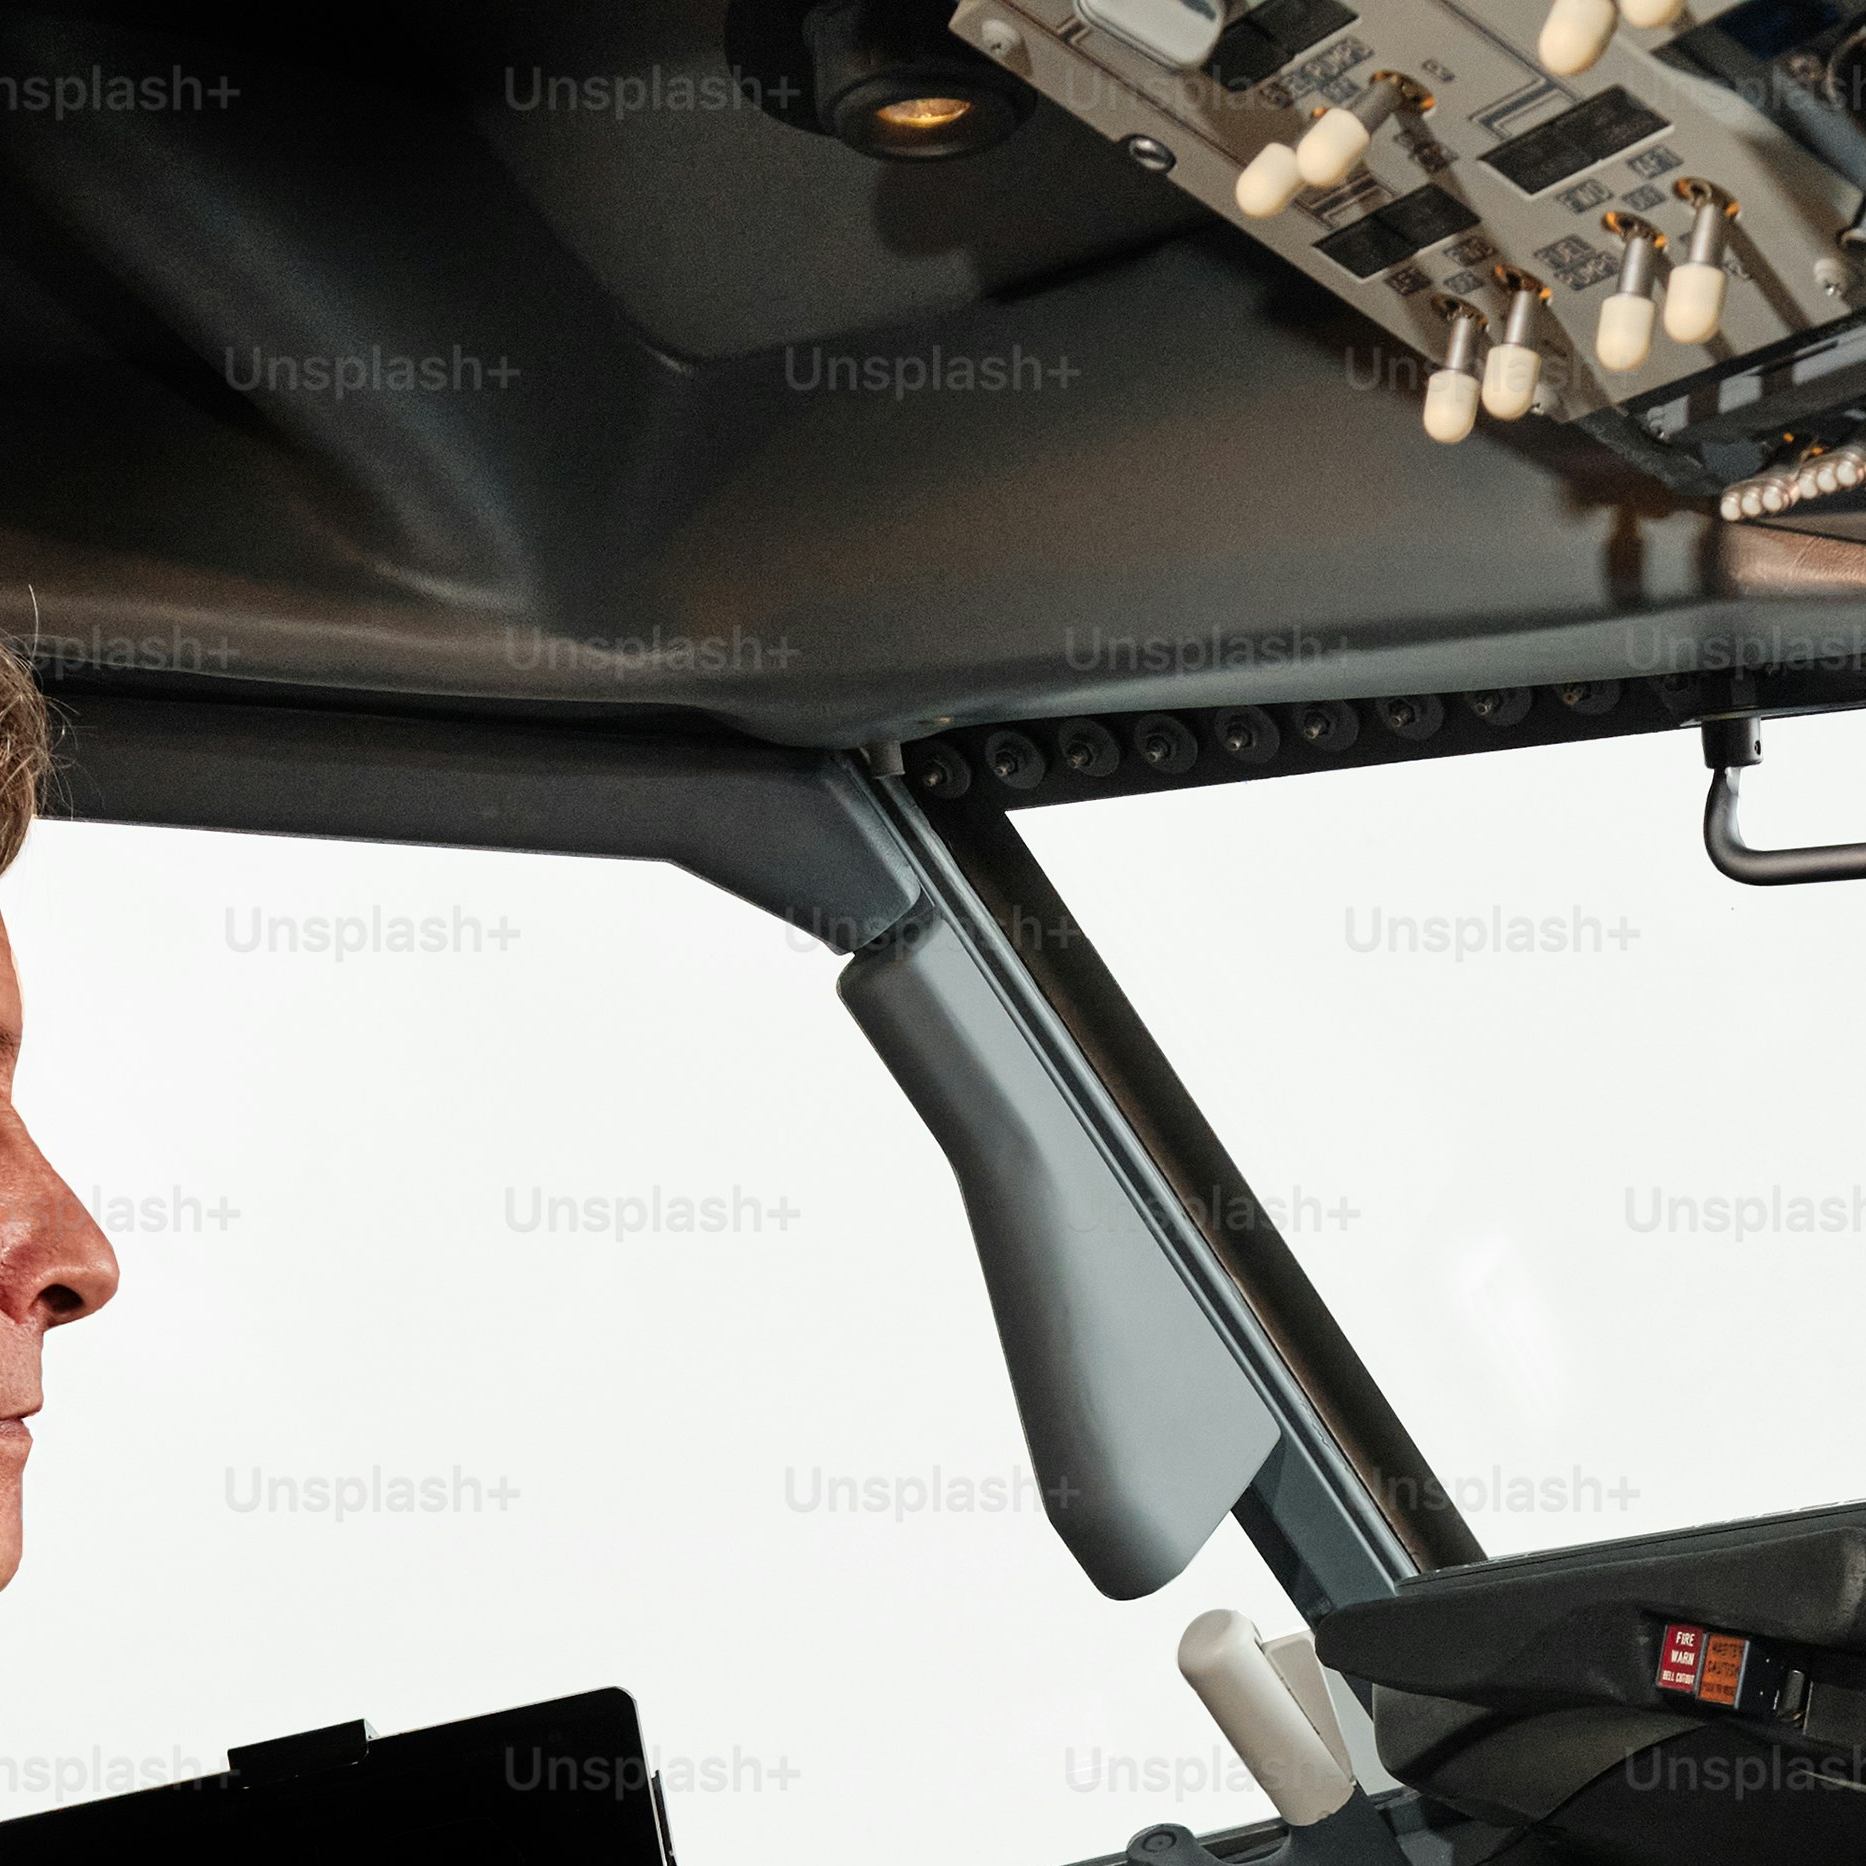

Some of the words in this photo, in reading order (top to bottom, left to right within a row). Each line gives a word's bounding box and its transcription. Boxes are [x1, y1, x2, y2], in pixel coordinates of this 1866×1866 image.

[1676, 1631, 1696, 1647] FIRE
[1671, 1651, 1695, 1666] WARN
[1662, 1670, 1675, 1682] BELL
